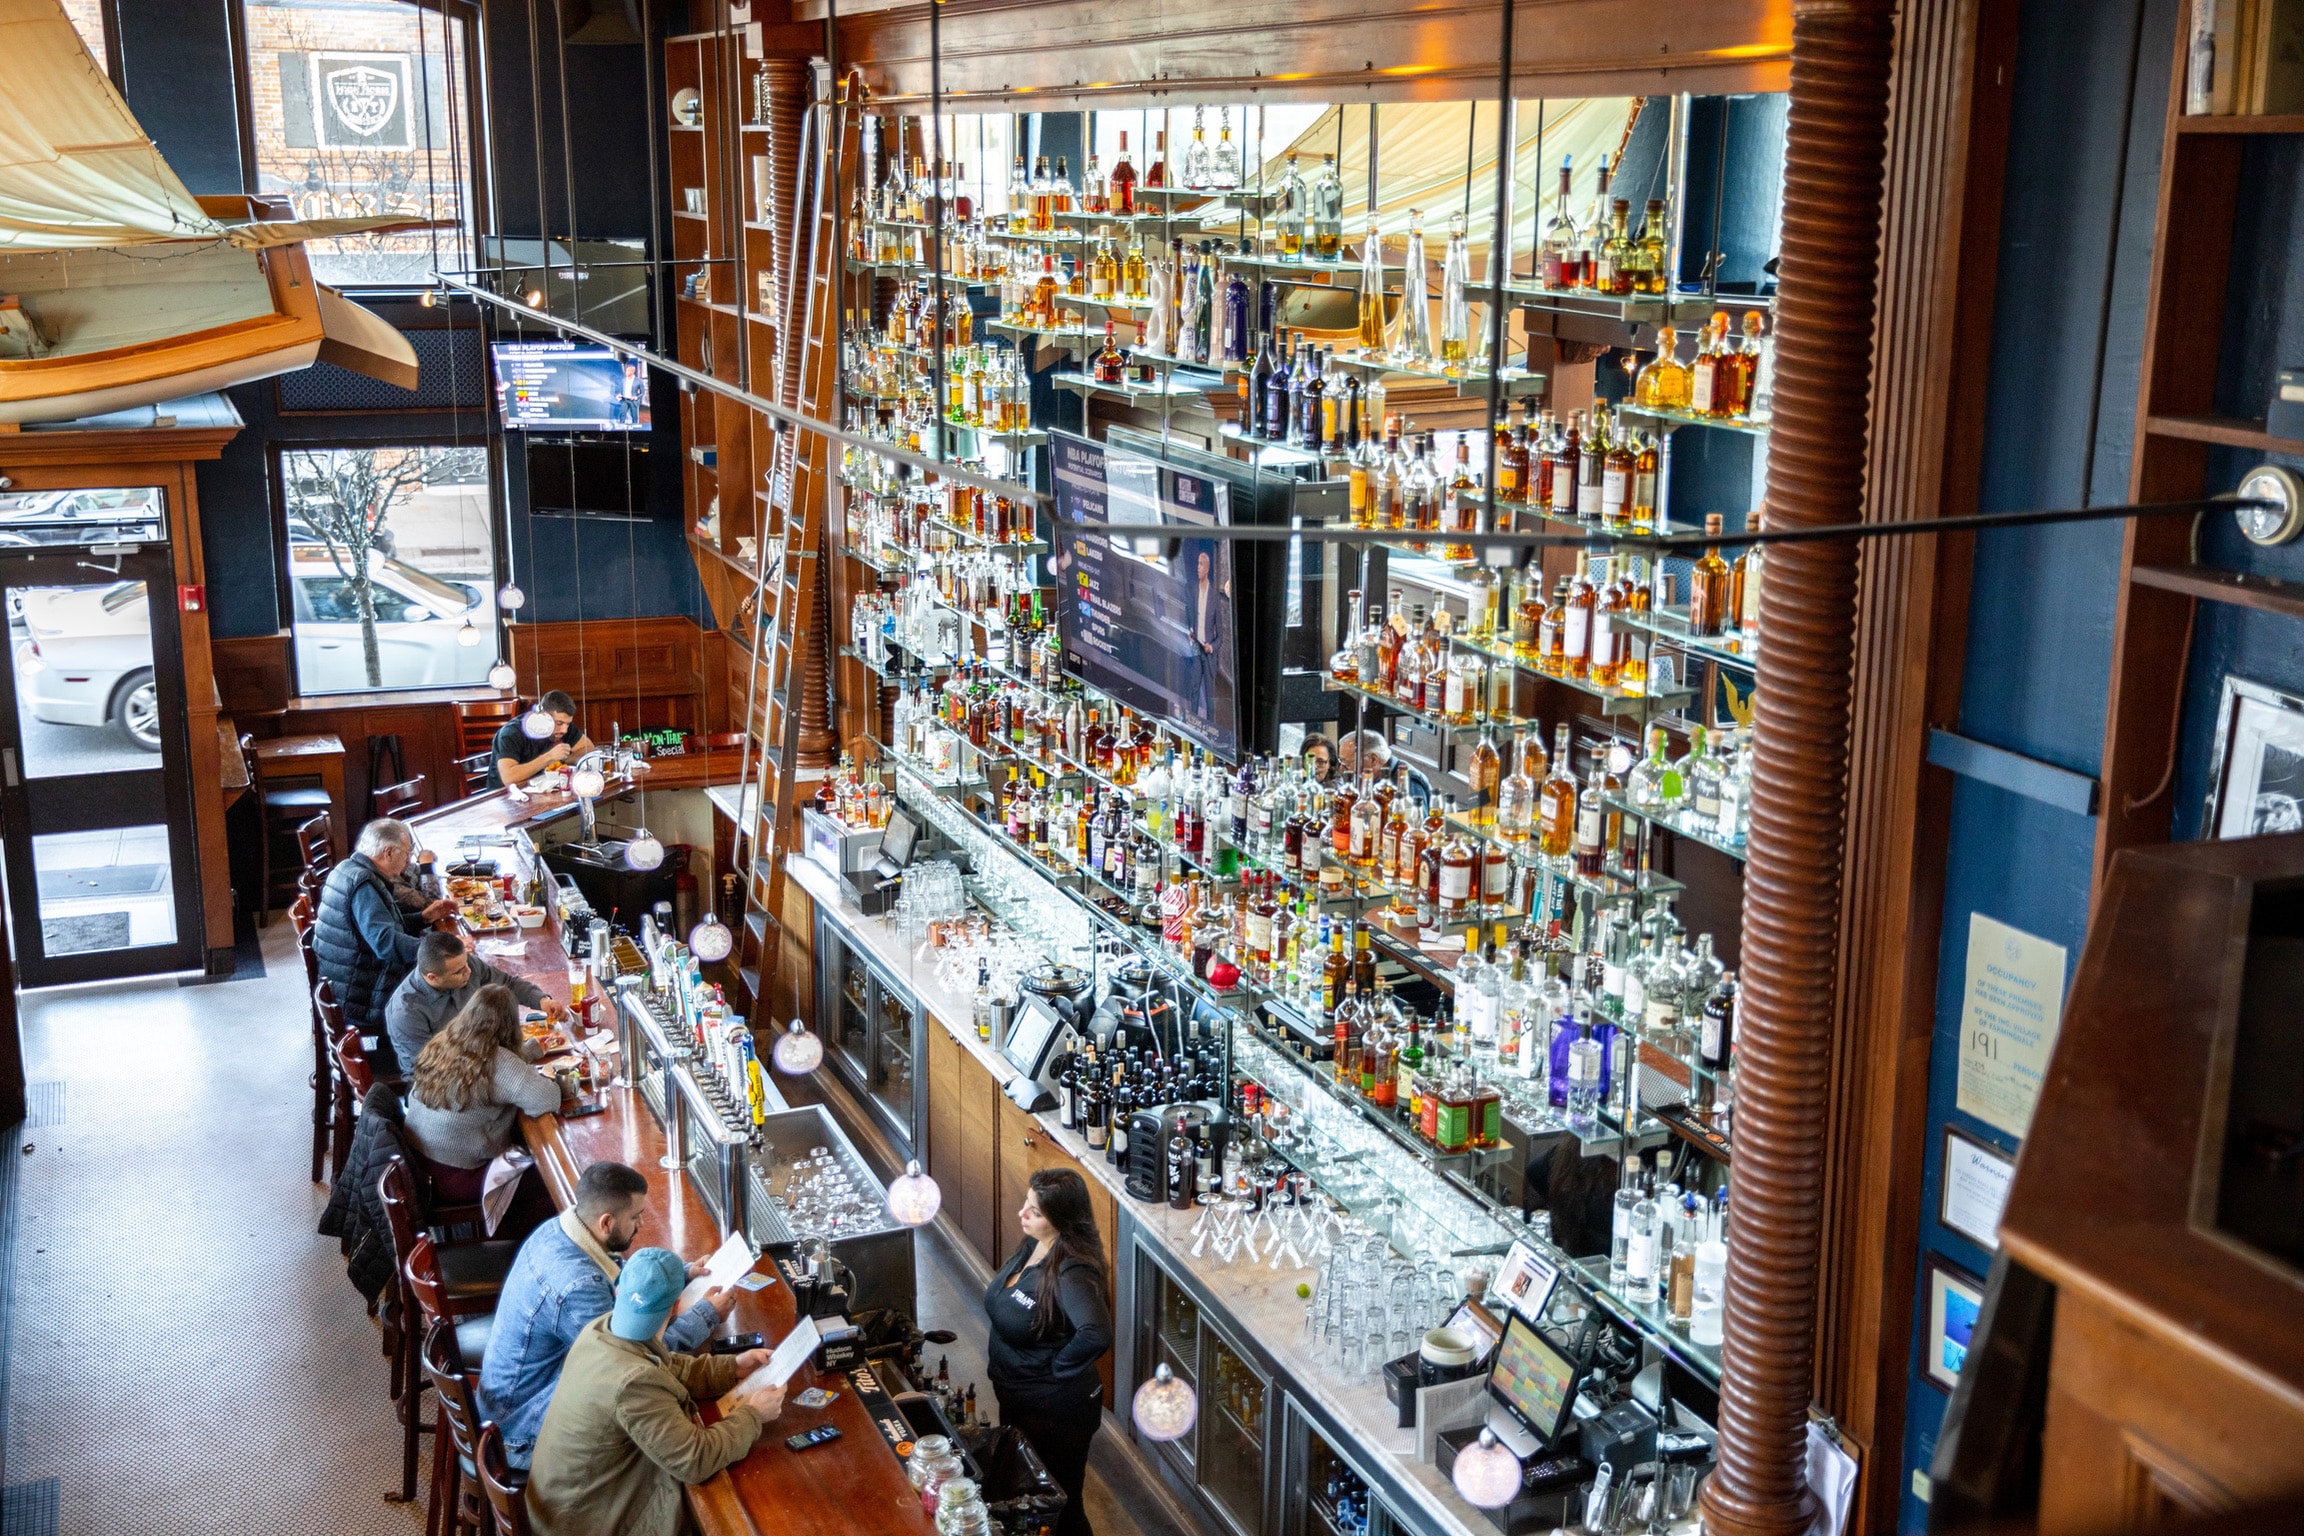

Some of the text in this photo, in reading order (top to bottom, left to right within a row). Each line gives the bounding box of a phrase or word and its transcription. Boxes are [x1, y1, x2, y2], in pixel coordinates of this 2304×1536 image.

[1067, 446, 1081, 463] NBA
[1082, 499, 1104, 515] PELICANS
[1089, 579, 1100, 592] JAZZ
[1090, 593, 1122, 616] TRAIL BLAZERS
[656, 744, 685, 757] Special
[1986, 963, 2037, 989] OCCUPANCY
[2008, 993, 2043, 1011] PREMISES
[2007, 1002, 2044, 1022] APPROVED
[1974, 1007, 1983, 1015] BY
[1984, 1011, 1997, 1020] THE
[2013, 1023, 2041, 1041] VILLAGE
[1972, 1030, 1997, 1060] 191
[1989, 1023, 2034, 1049] FARMINGDALE
[2013, 1062, 2043, 1081] PERSON
[1970, 1153, 2008, 1181] Warnin
[825, 1345, 853, 1354] Hudson
[826, 1351, 855, 1360] Whiskey
[826, 1360, 837, 1368] NY
